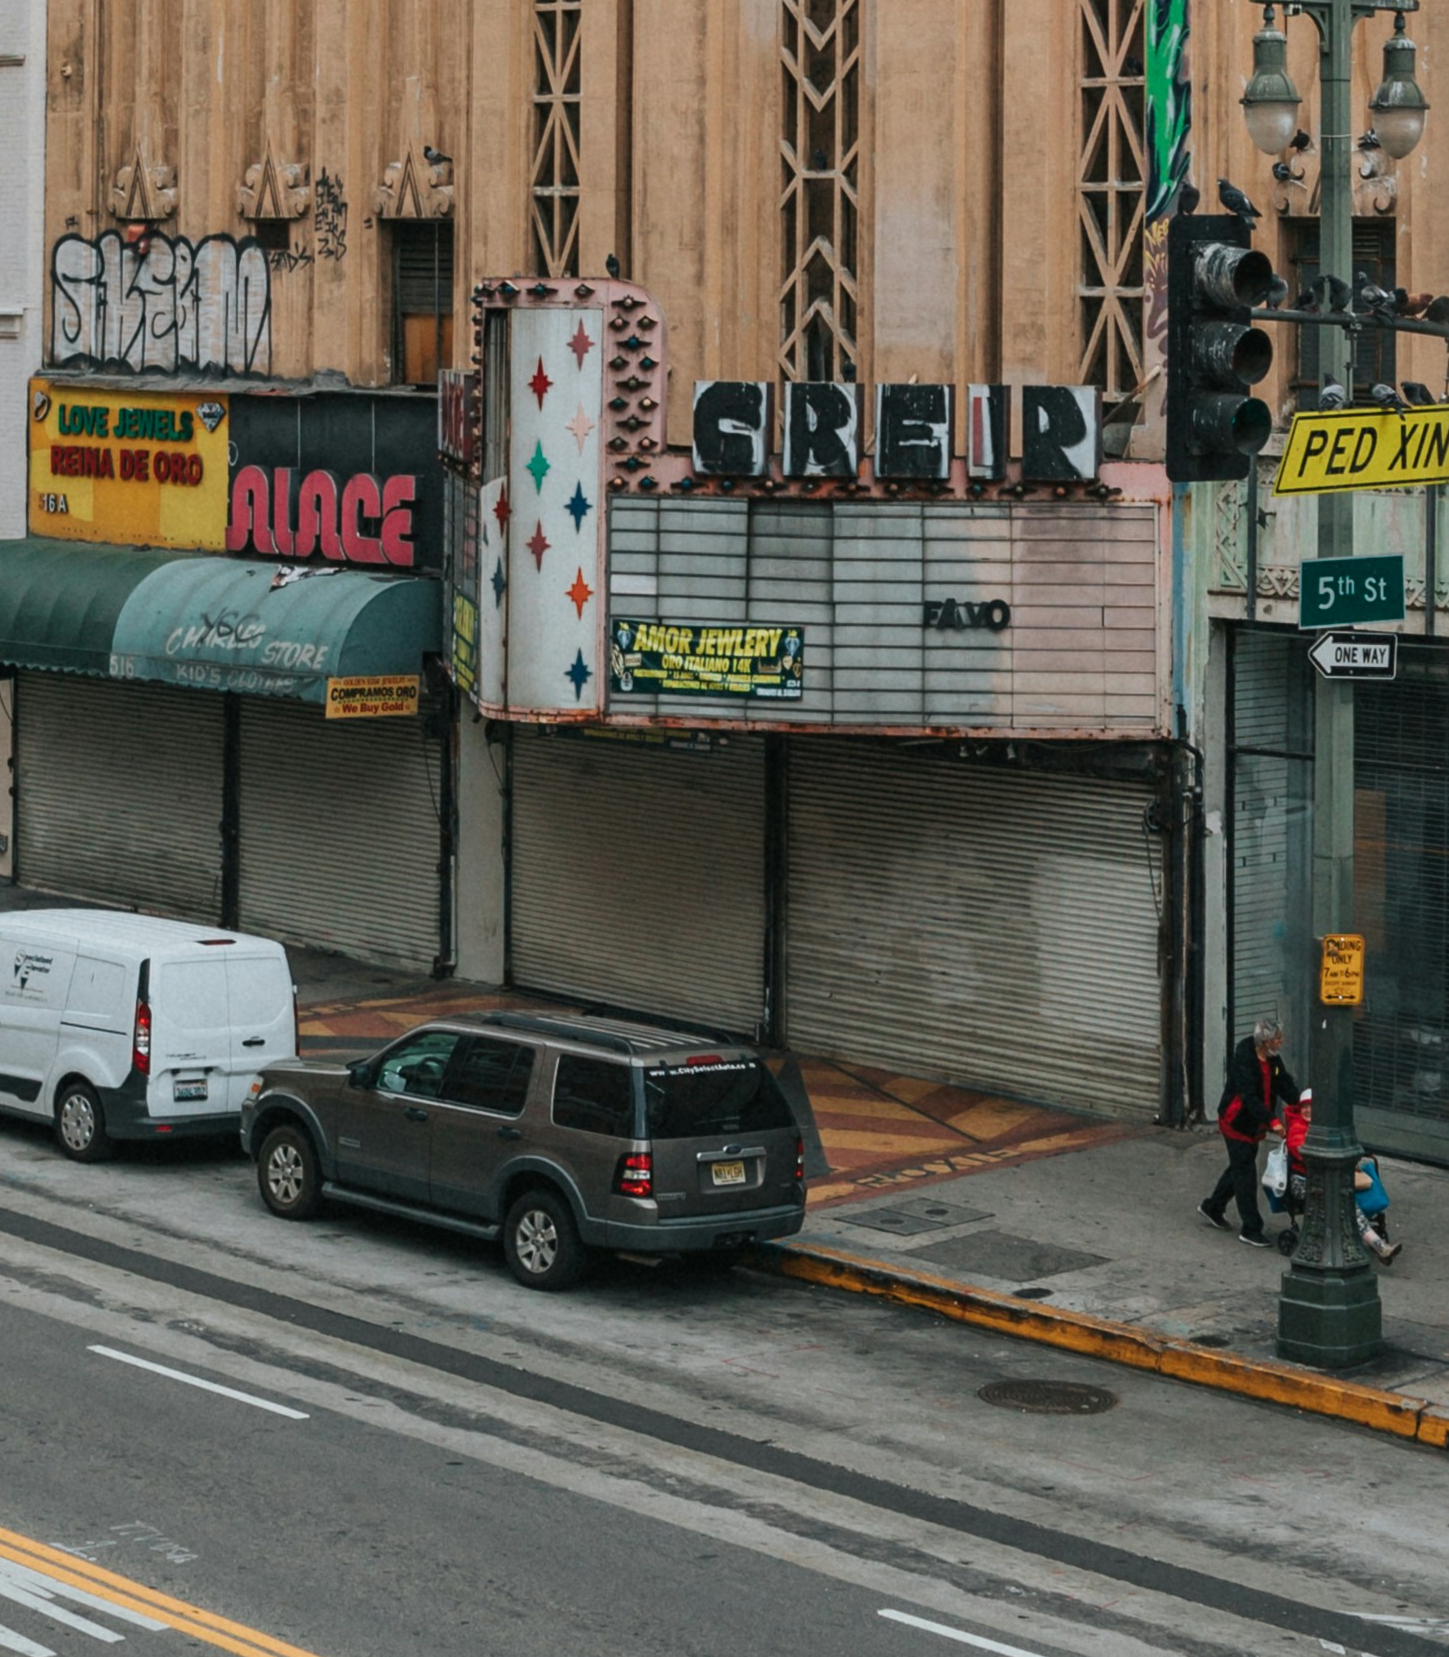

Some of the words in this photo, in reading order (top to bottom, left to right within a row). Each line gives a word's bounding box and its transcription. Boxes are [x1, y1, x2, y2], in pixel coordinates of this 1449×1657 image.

[58, 404, 109, 438] LOVE
[113, 407, 194, 442] JEWELS
[1298, 426, 1377, 477] PED
[50, 445, 114, 479] REINA
[119, 448, 150, 481] DE
[153, 451, 203, 485] ORO
[57, 494, 68, 513] A
[1318, 576, 1354, 610] 5th
[1364, 577, 1387, 602] St
[633, 624, 692, 654] AMOR
[695, 628, 783, 657] JEWLERY
[109, 655, 135, 676] 516
[262, 641, 329, 669] STORE
[662, 655, 682, 669] ORO
[684, 657, 730, 672] ITALIANO
[732, 659, 751, 673] 14K
[1335, 647, 1359, 663] ONE
[1362, 647, 1387, 664] WAY
[176, 663, 221, 684] KID'S
[331, 687, 393, 700] COMPRAMOS
[396, 686, 416, 698] ORO
[342, 704, 358, 713] We
[360, 703, 379, 714] Buy
[381, 702, 403, 712] Gold
[1332, 954, 1352, 964] ONLY
